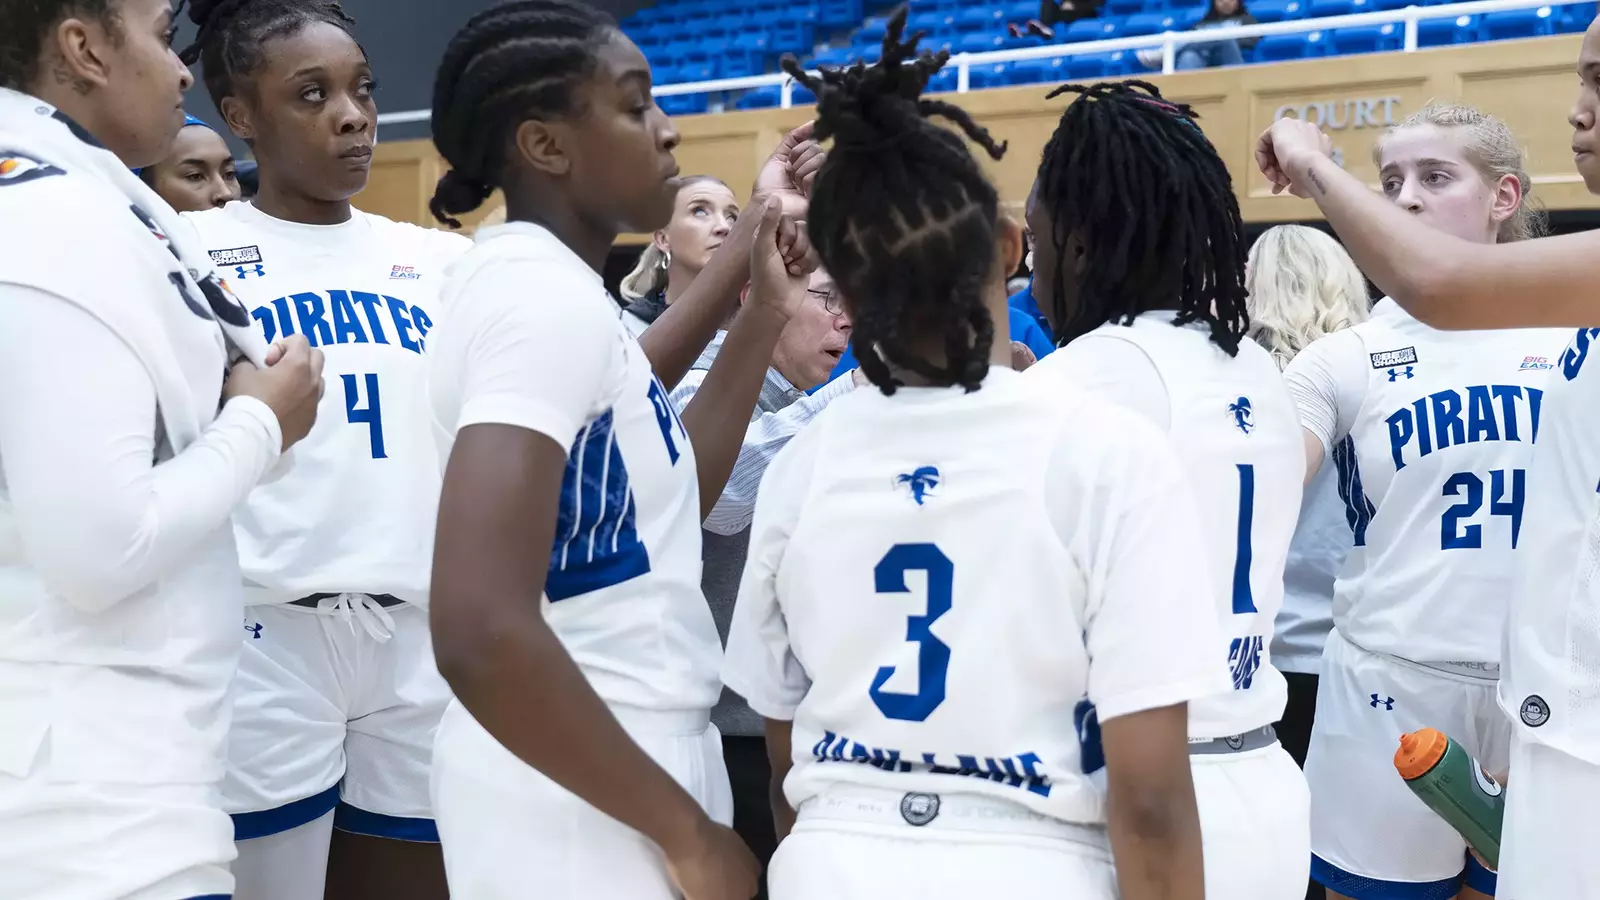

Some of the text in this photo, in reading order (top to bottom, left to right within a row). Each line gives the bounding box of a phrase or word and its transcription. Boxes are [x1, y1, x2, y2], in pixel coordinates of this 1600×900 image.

[391, 264, 415, 272] BIG
[390, 271, 422, 280] EAST
[1373, 356, 1416, 367] CHANGE
[1523, 356, 1548, 364] BIG
[1519, 362, 1555, 370] EAST
[339, 373, 389, 459] 4
[1440, 469, 1526, 551] 24
[1232, 464, 1259, 614] 1
[868, 542, 954, 722] 3
